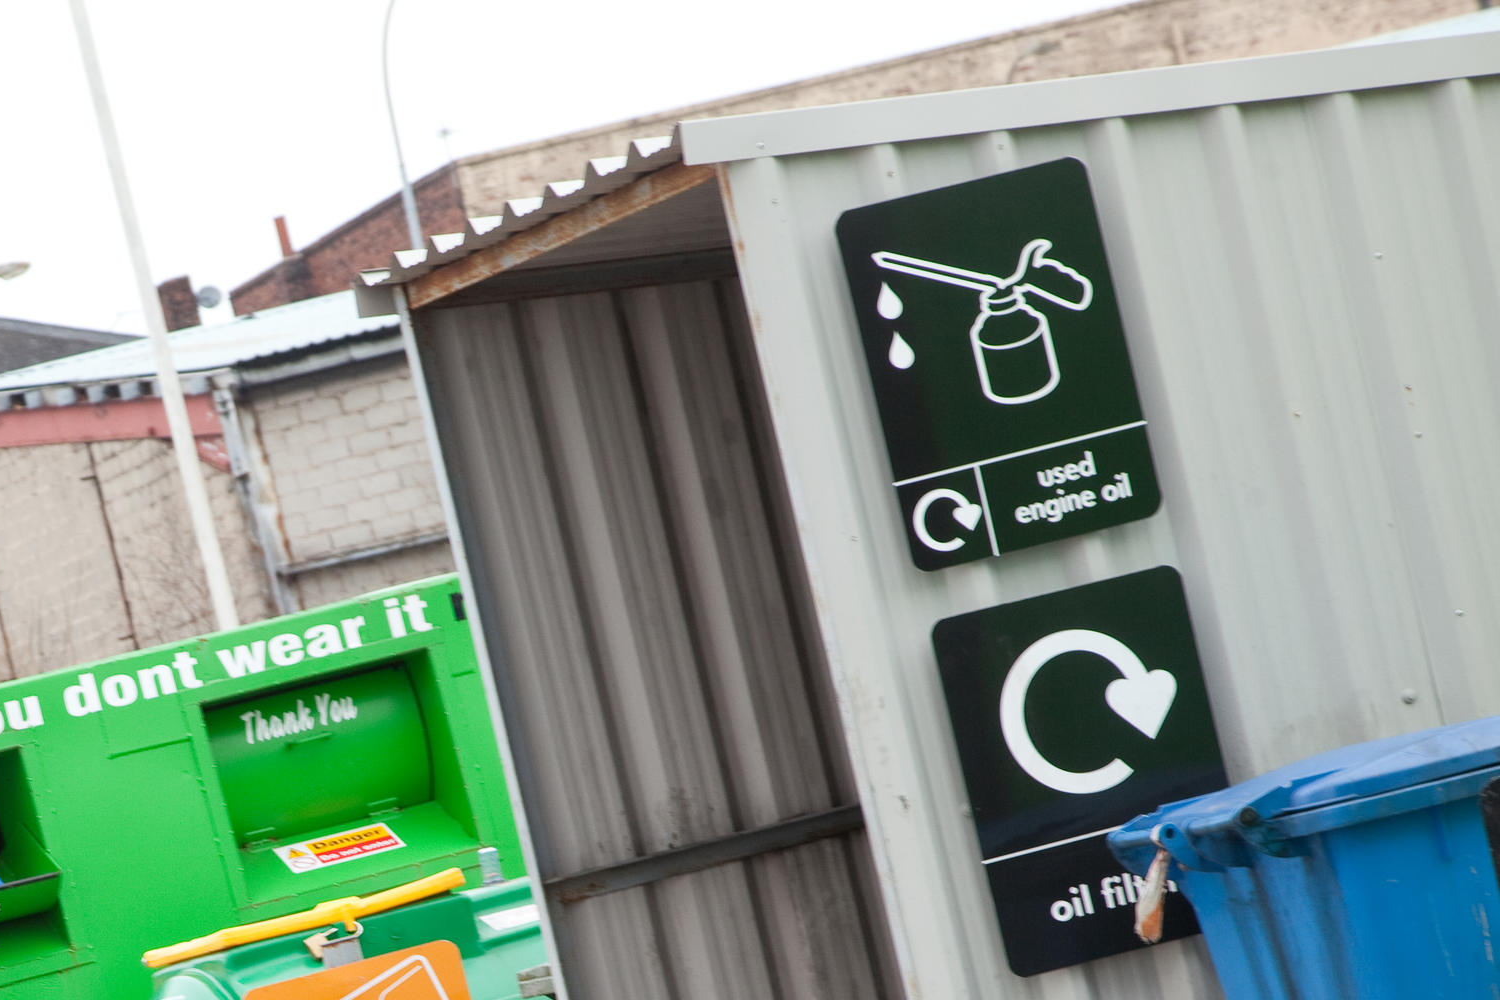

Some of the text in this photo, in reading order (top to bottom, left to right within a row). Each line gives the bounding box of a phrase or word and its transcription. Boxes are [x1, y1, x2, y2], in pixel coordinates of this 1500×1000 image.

[1036, 450, 1097, 487] used
[1014, 472, 1133, 523] engine oil
[63, 652, 203, 717] dont
[217, 615, 366, 678] wear
[382, 594, 433, 638] it
[239, 693, 357, 744] Thank You
[312, 829, 380, 850] Danger
[1050, 883, 1095, 922] oil
